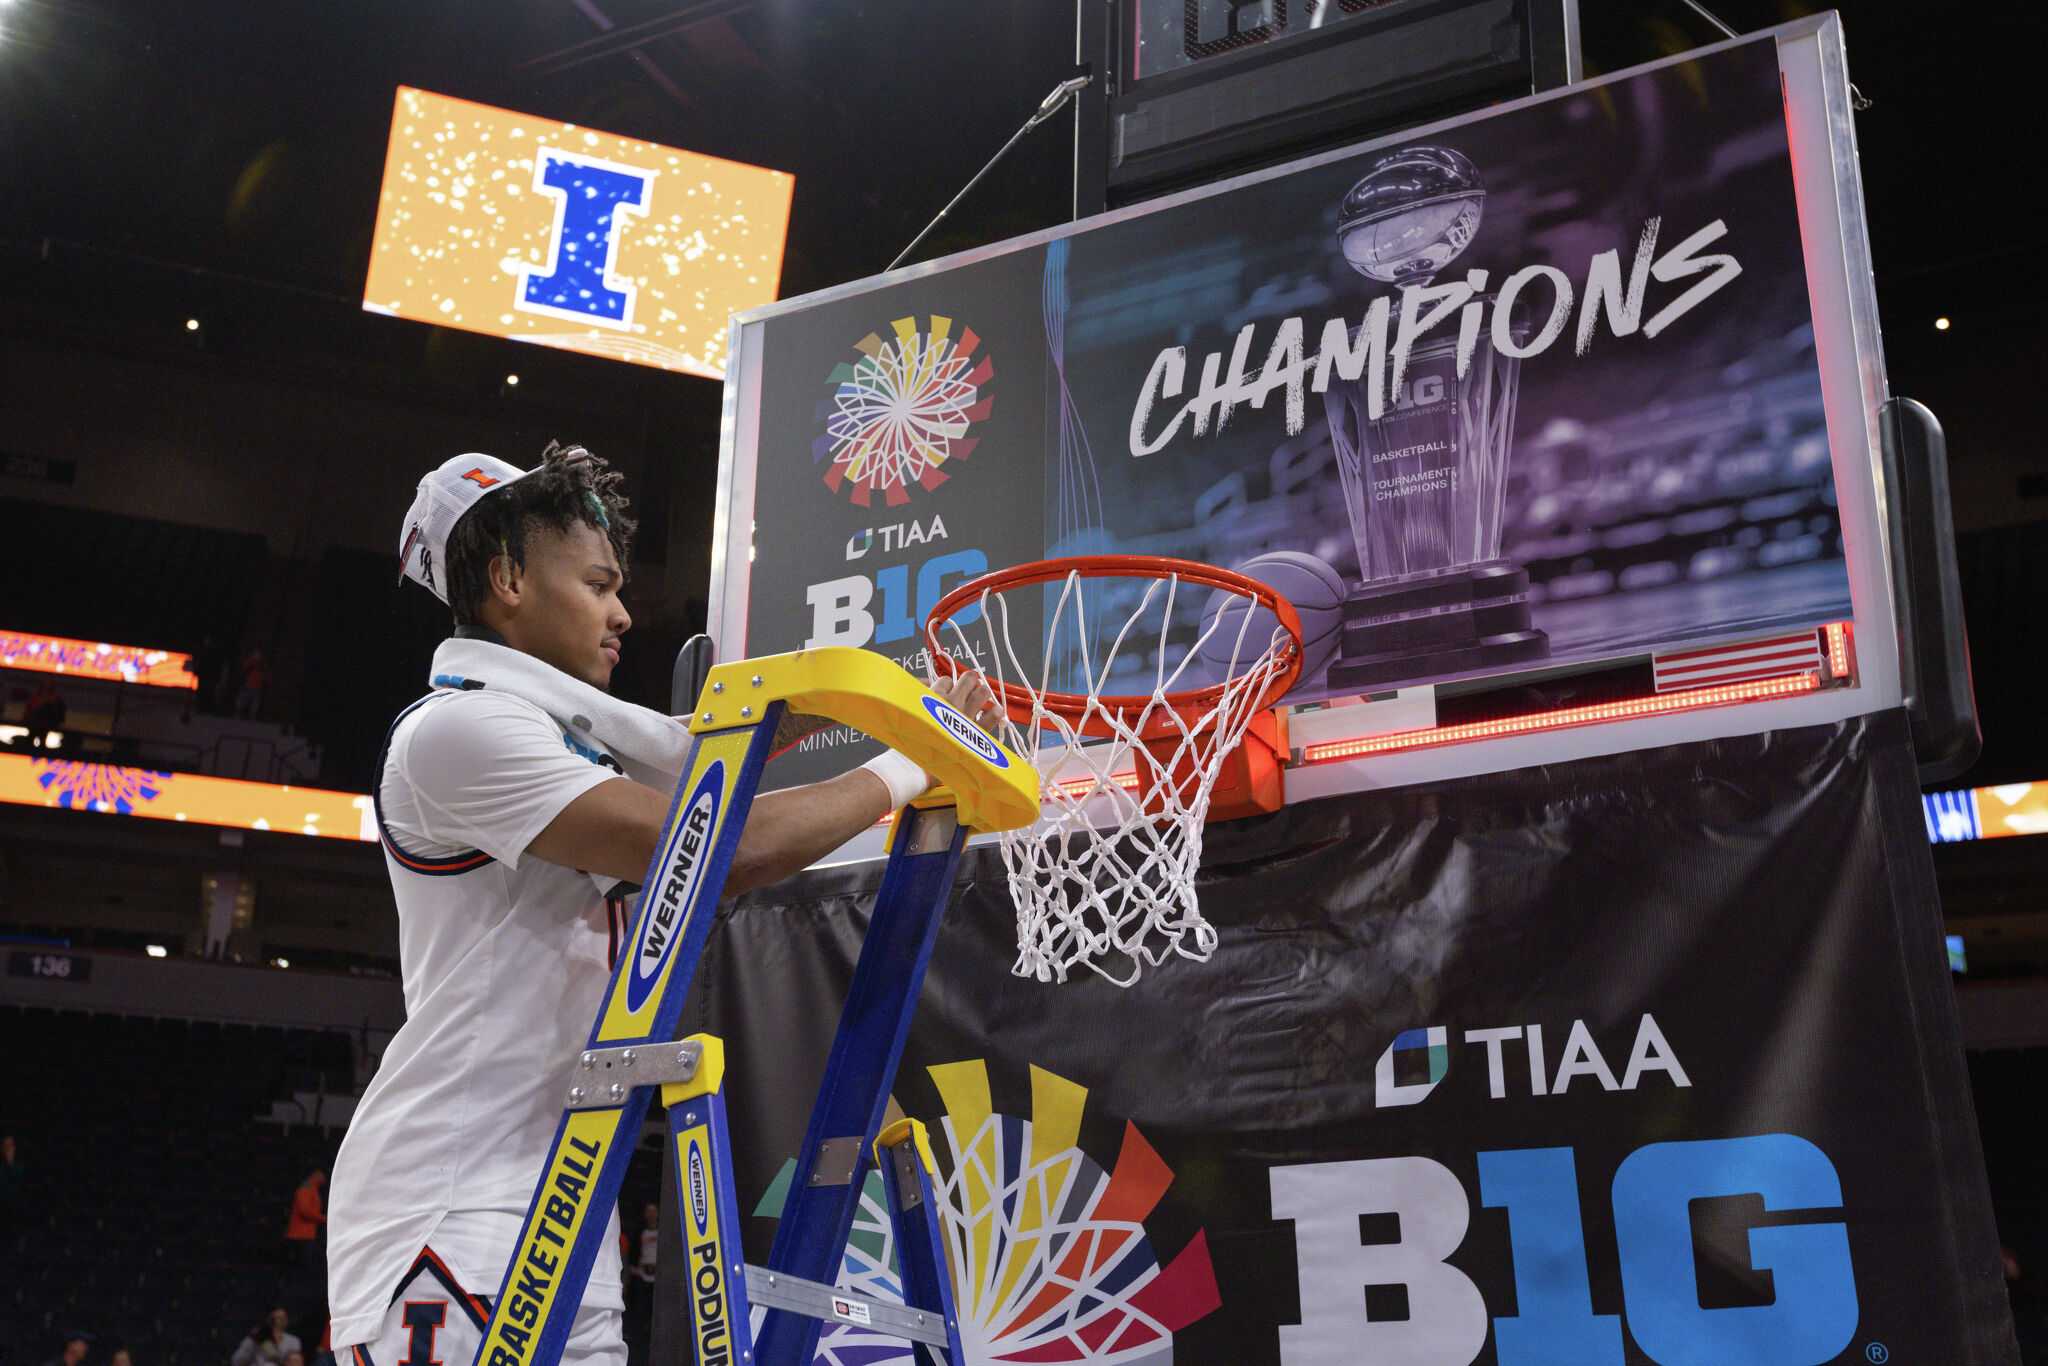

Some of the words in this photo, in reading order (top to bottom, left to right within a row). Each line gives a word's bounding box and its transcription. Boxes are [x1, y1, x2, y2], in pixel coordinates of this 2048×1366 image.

[1372, 440, 1447, 464] BASKETBALL
[1372, 467, 1451, 491] TOURNAMENT
[1376, 479, 1448, 501] CHAMPIONS
[878, 514, 948, 552] TIAA
[941, 708, 992, 756] WERNER
[643, 806, 709, 960] WERNER
[1464, 1013, 1692, 1099] TIAA
[691, 1158, 705, 1218] WERNER
[487, 1136, 601, 1366] BASKETBALL
